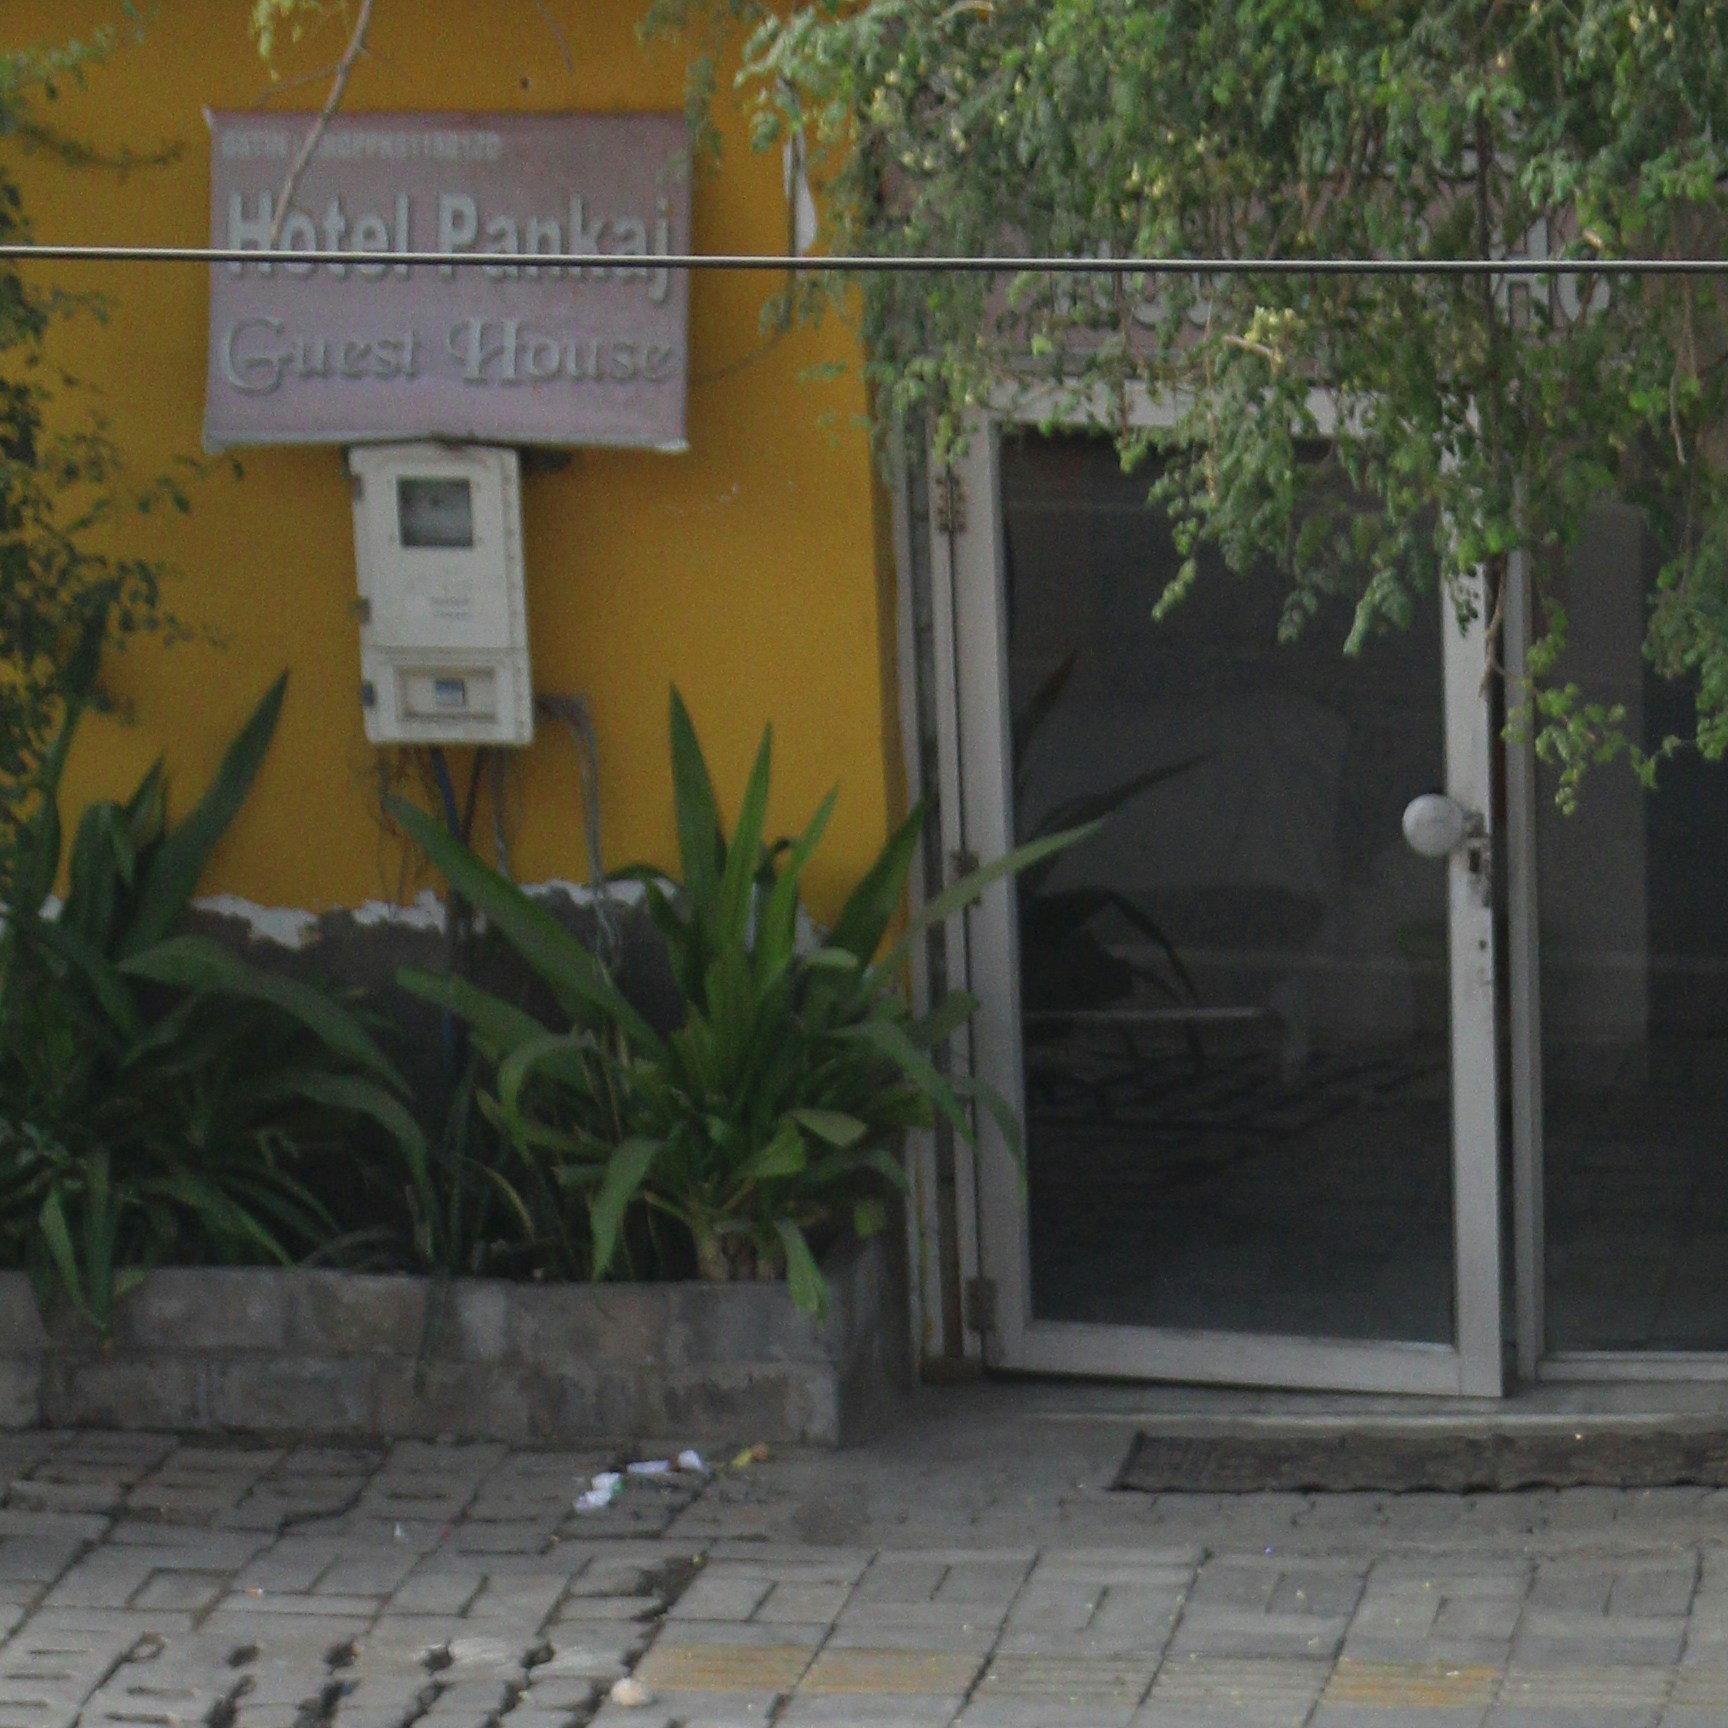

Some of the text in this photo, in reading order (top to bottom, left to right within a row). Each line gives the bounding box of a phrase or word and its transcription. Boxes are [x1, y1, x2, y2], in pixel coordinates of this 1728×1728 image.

[226, 192, 674, 306] Hotel Pankaj
[221, 316, 677, 395] Guest House
